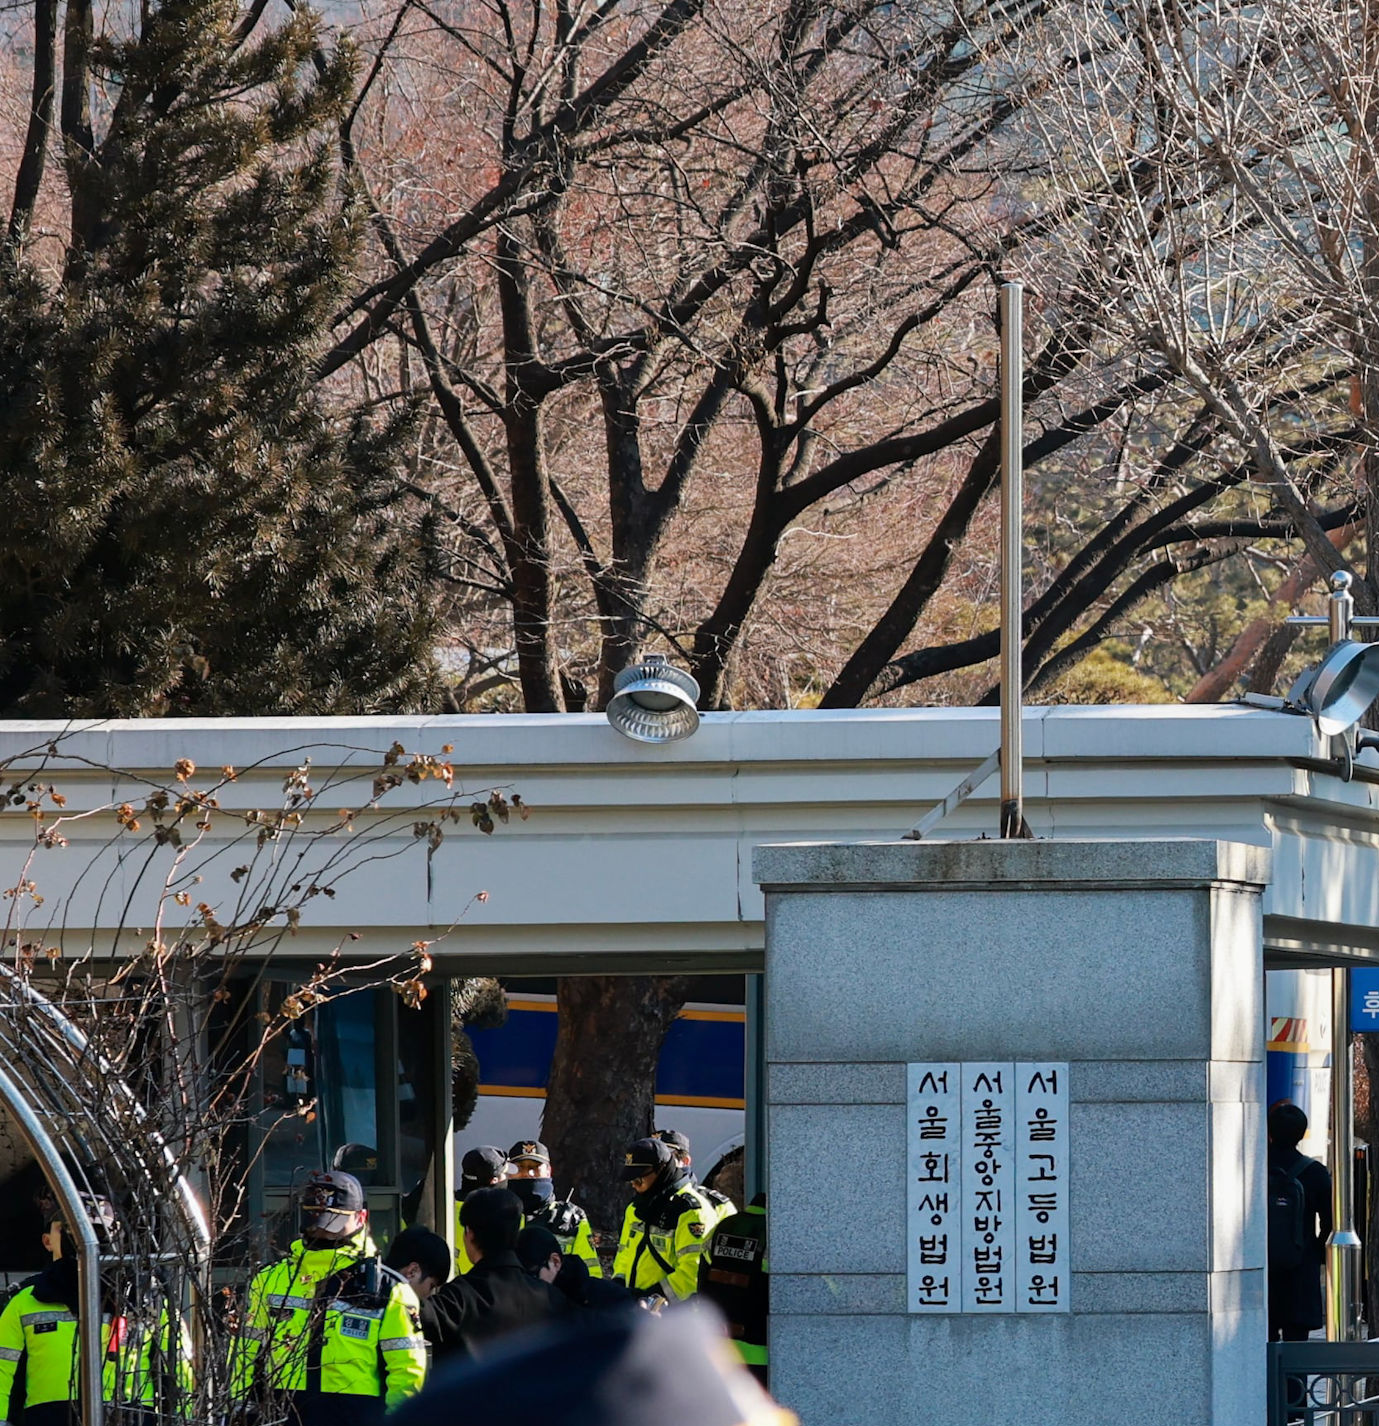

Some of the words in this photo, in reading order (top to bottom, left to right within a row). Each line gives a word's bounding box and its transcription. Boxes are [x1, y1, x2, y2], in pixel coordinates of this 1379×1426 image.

[717, 1246, 750, 1259] POLICE
[918, 1070, 949, 1306] 서울회생법원
[973, 1070, 1003, 1305] 서울중앙지방법원
[1027, 1069, 1058, 1306] 서울고등법원
